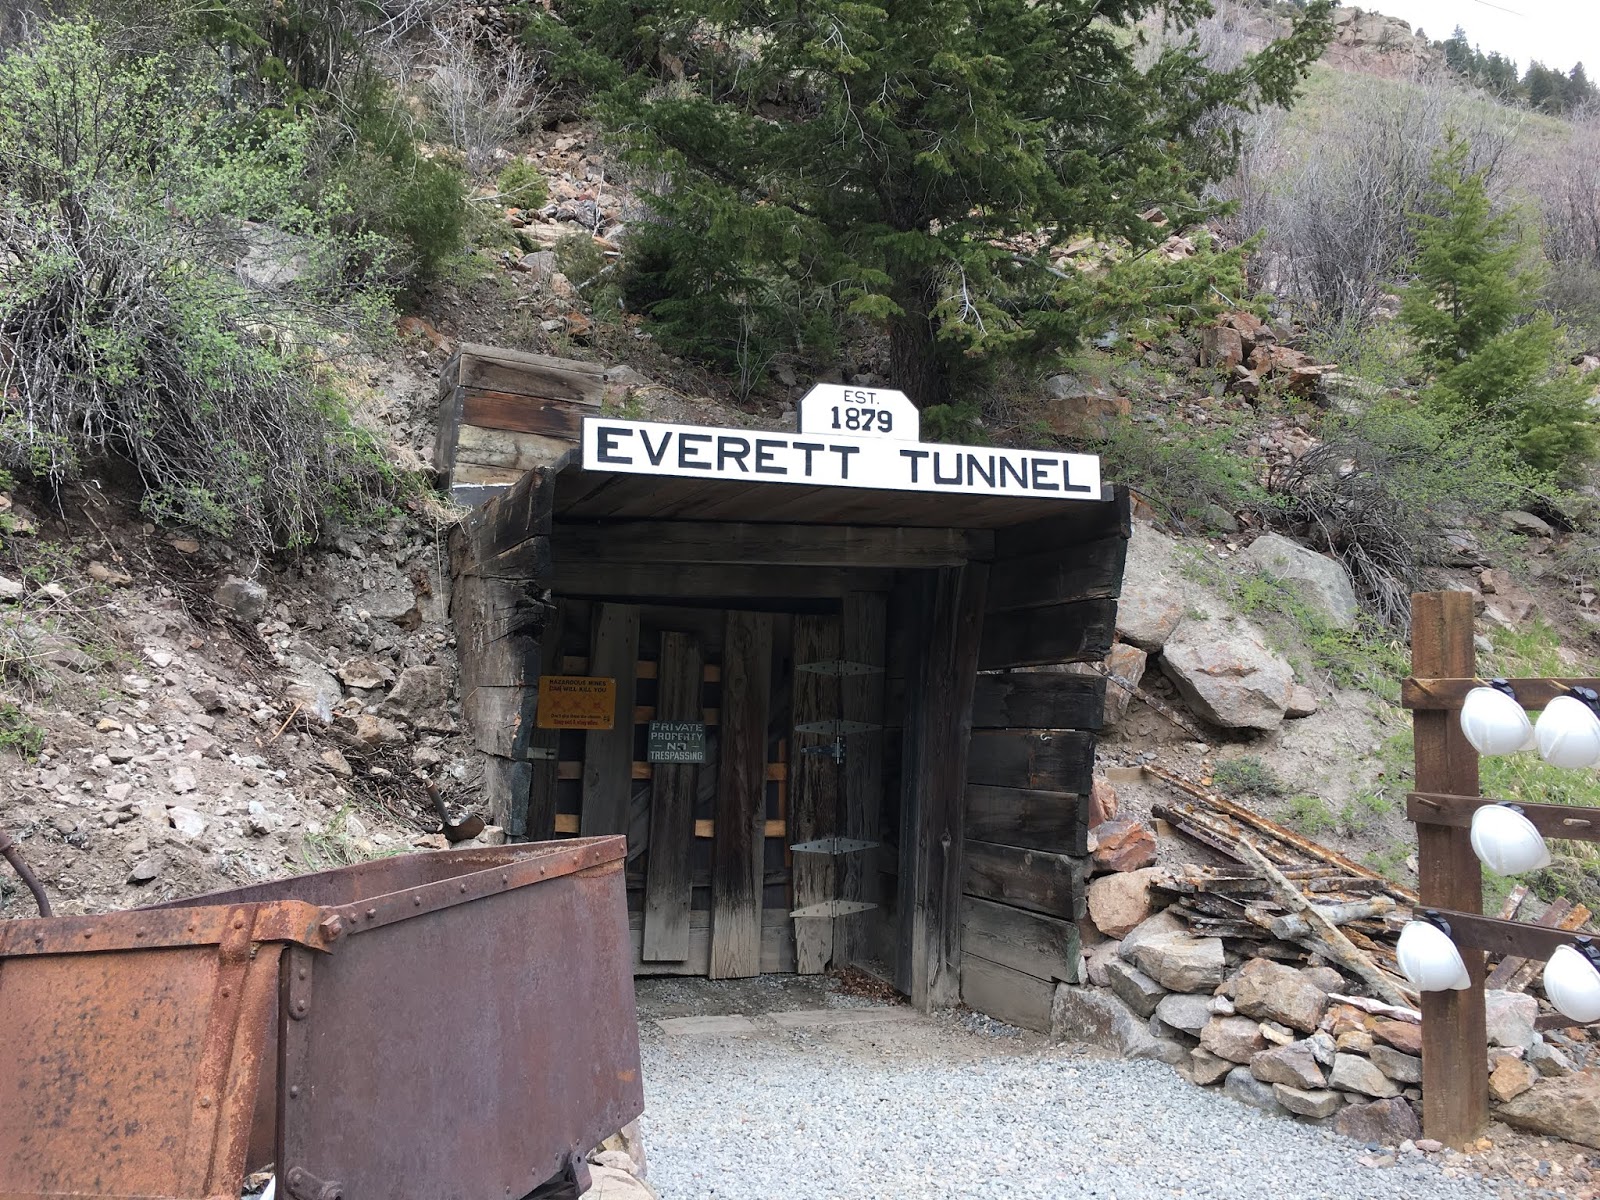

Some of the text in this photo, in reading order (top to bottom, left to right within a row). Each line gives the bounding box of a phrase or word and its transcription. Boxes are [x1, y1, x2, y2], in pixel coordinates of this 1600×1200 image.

[844, 389, 880, 405] EST.
[831, 406, 893, 433] 1879
[597, 426, 1092, 493] EVERETT TUNNEL
[652, 722, 703, 732] PRIVATE
[651, 732, 703, 741] PROPERTY
[650, 751, 704, 761] TRESPASSING
